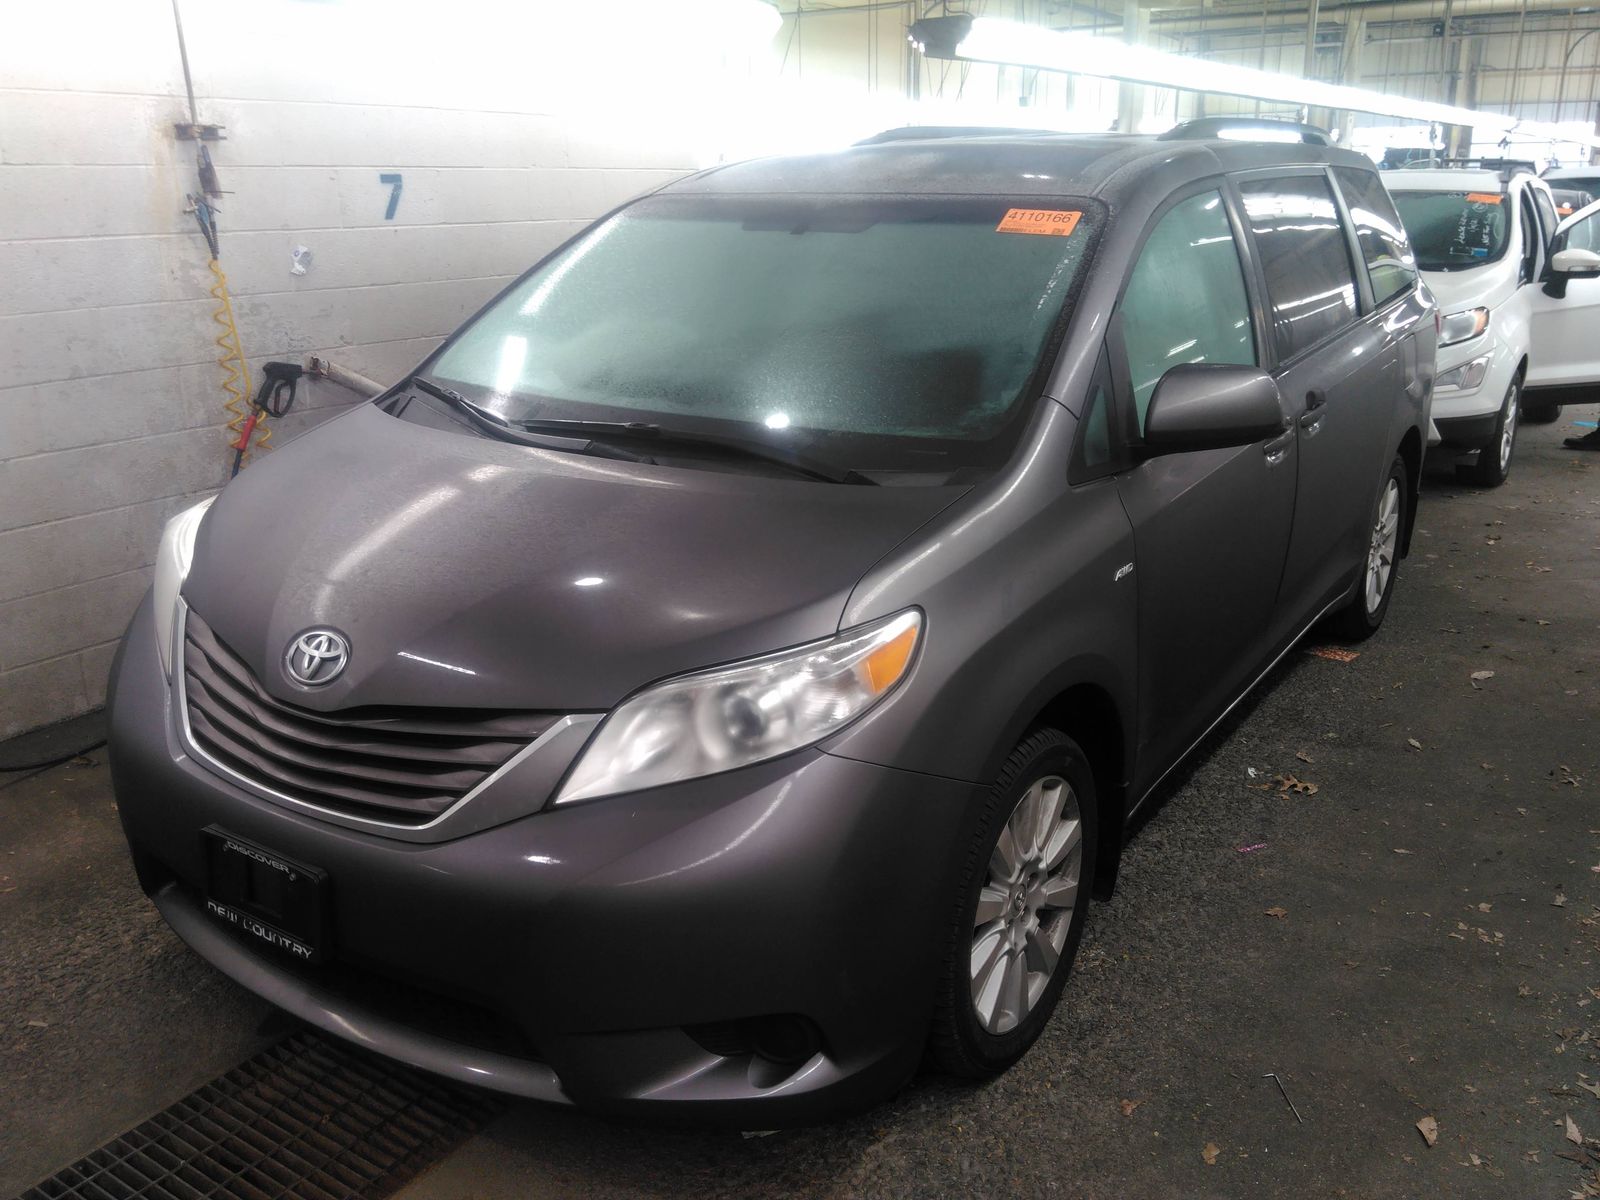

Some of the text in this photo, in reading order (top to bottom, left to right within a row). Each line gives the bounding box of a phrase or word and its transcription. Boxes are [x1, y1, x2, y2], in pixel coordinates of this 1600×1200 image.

[380, 173, 403, 221] 7
[1008, 210, 1073, 224] 4110166
[226, 840, 291, 874] DISCOVER
[243, 918, 313, 959] COUNTRY
